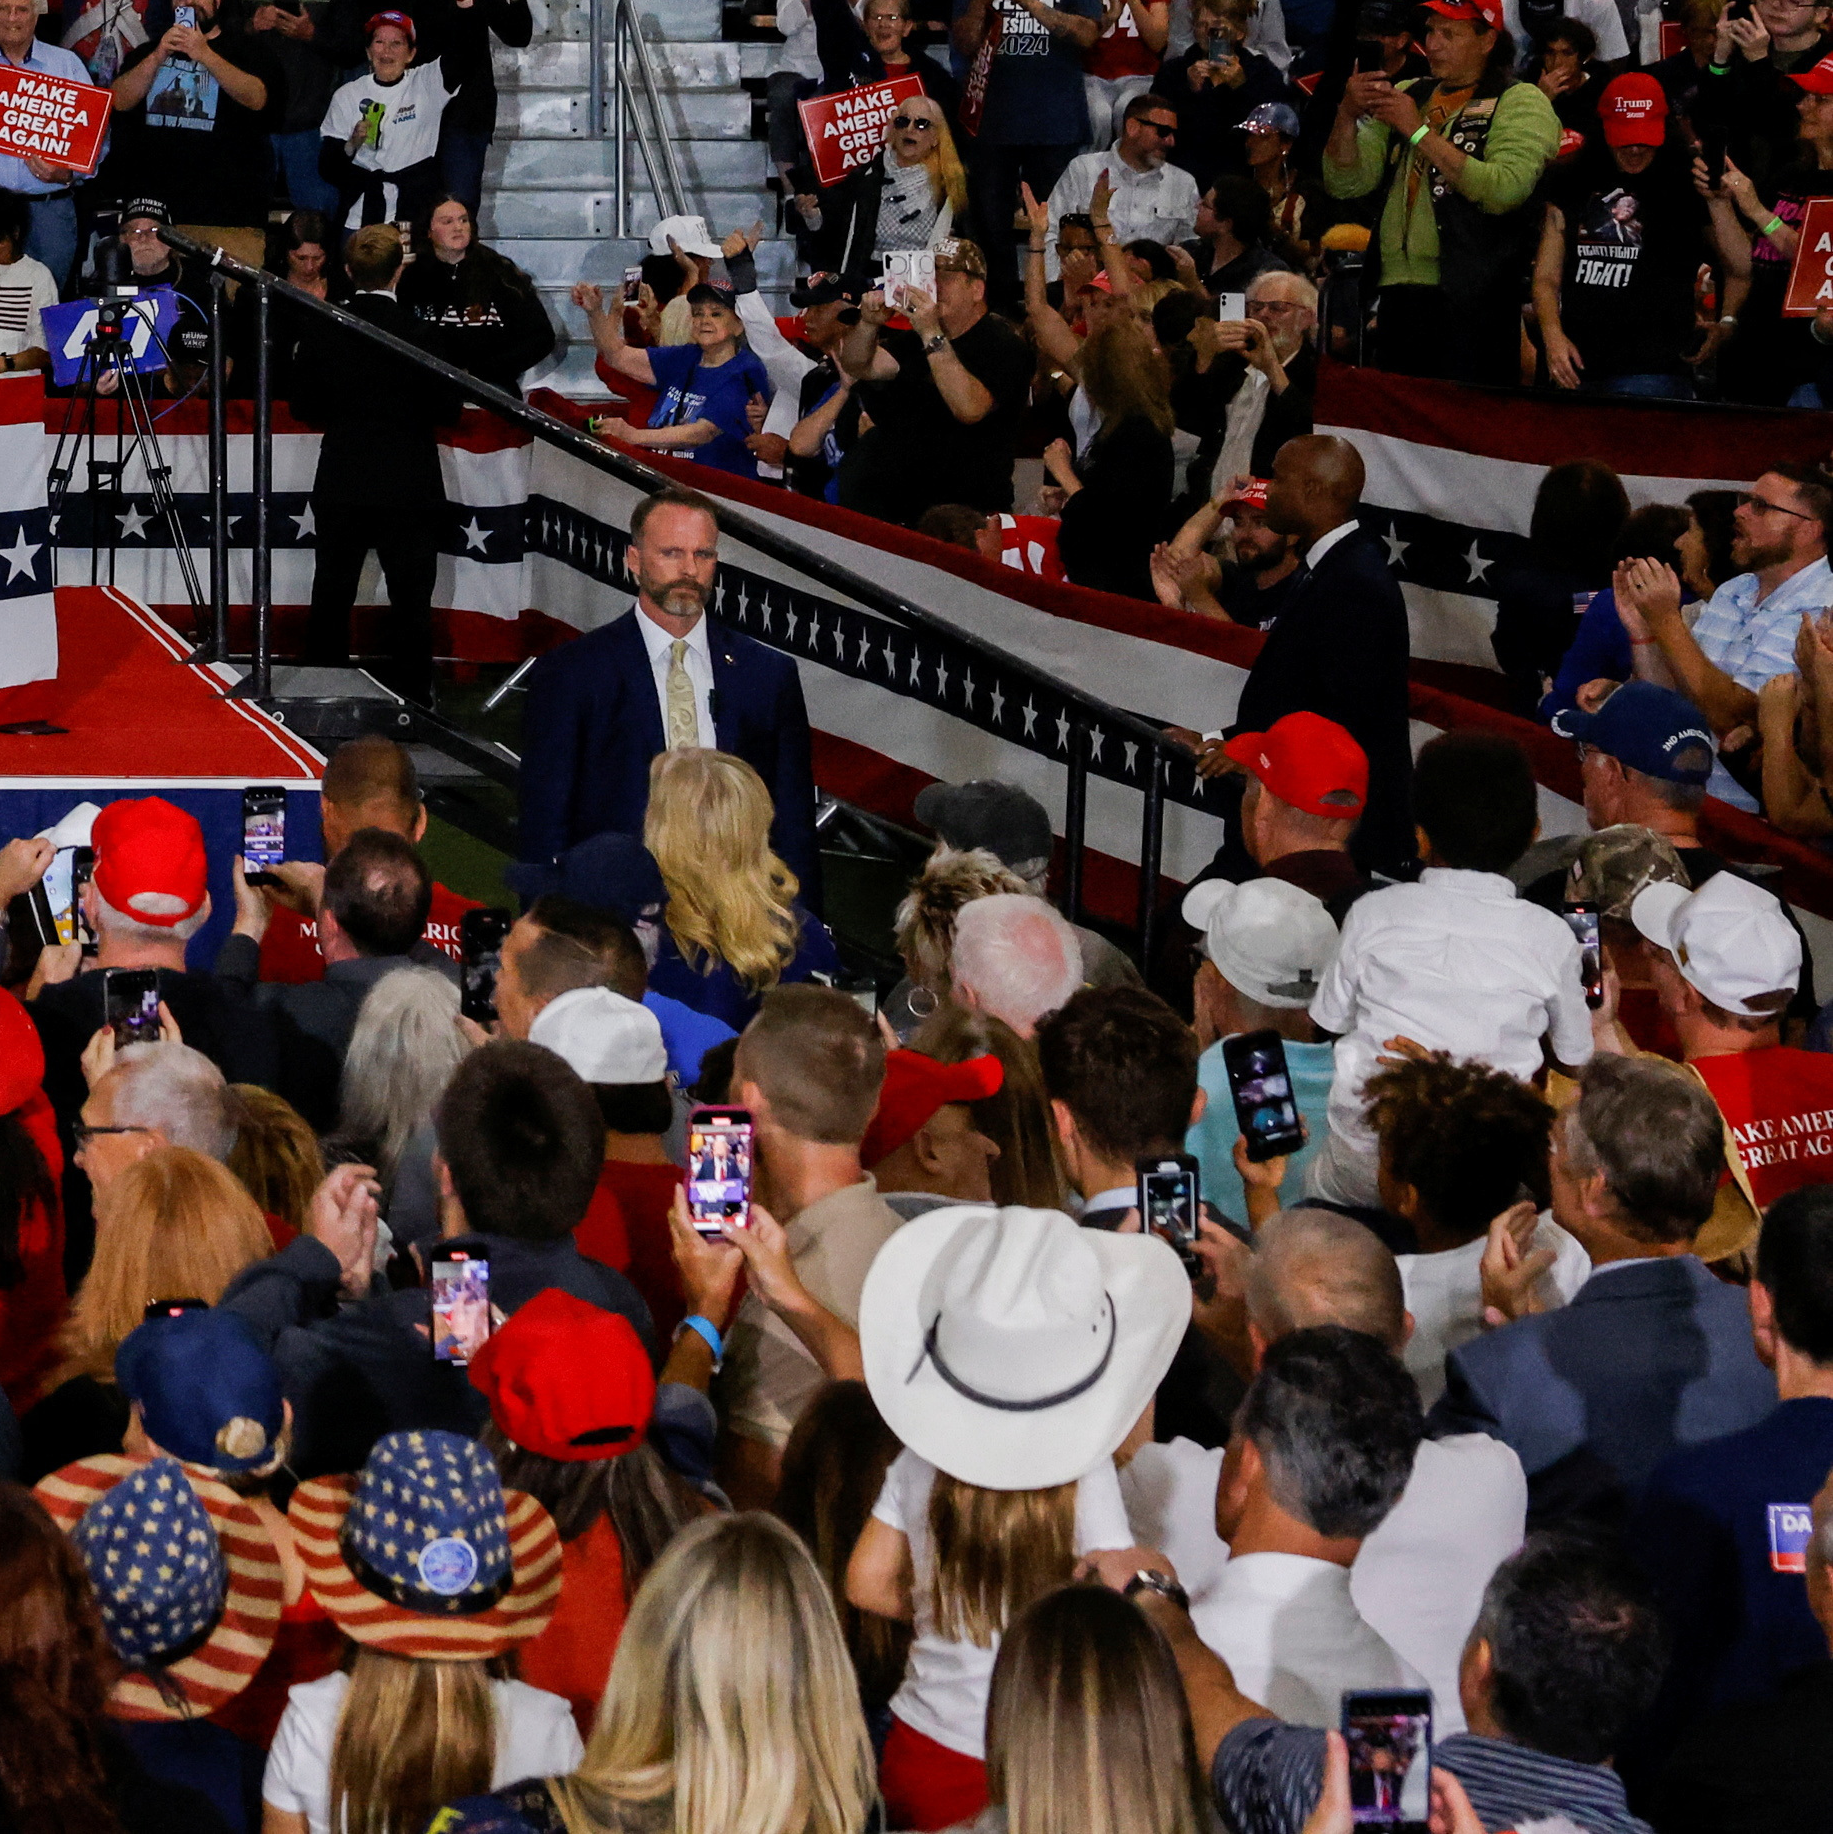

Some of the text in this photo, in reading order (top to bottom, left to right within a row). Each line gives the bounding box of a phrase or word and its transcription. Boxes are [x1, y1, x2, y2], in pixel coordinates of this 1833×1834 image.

[16, 77, 79, 106] MAKE
[834, 89, 895, 116] MAKE
[1616, 97, 1652, 109] Trump
[2, 111, 75, 140] GREAT
[1576, 259, 1632, 287] FIGHT!
